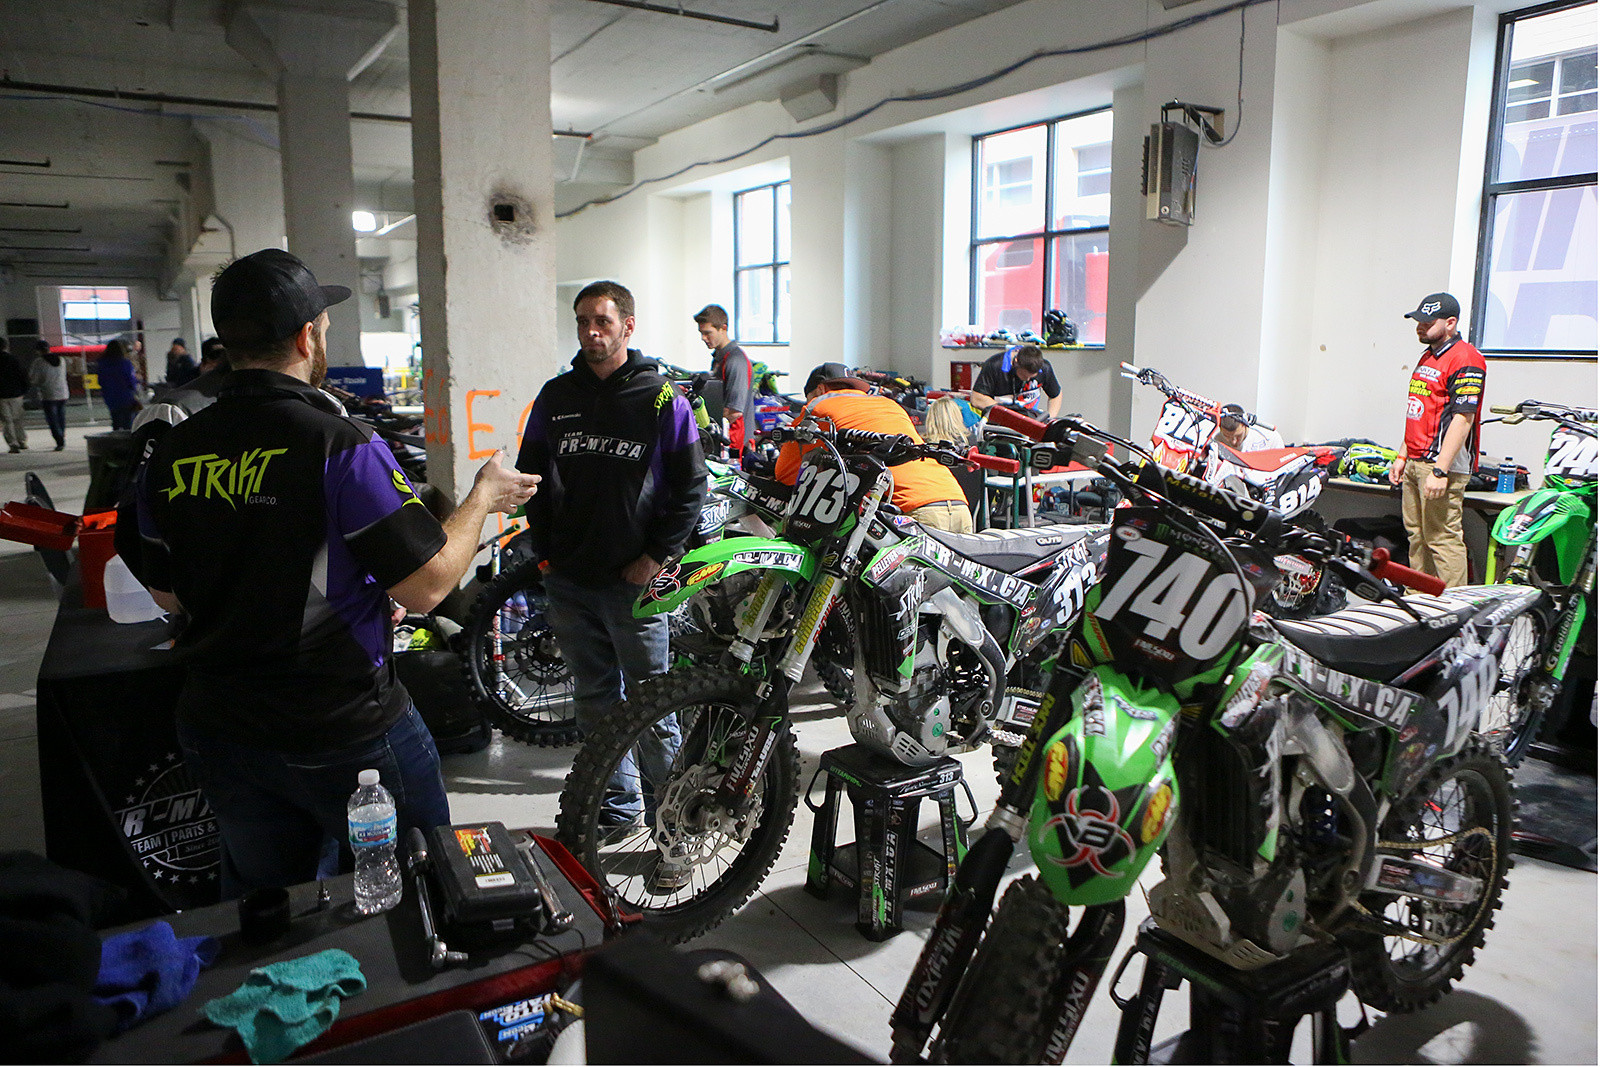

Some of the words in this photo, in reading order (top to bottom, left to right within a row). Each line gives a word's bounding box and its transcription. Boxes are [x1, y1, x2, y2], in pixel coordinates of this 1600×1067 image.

[559, 437, 643, 459] PR-MX.CA
[1157, 402, 1217, 449] 814
[1544, 433, 1598, 476] 24
[159, 447, 289, 511] STRIKT
[789, 464, 861, 524] 313
[1279, 474, 1323, 515] 814
[924, 540, 1031, 606] PR-MX.CA
[1053, 561, 1098, 625] 313
[1095, 537, 1256, 661] 740
[1428, 614, 1459, 629] GUTS
[1286, 650, 1412, 726] PR-MX.CA
[1437, 653, 1497, 755] 740
[939, 771, 955, 784] 313
[132, 836, 161, 854] TEAM
[171, 823, 205, 843] PARTS
